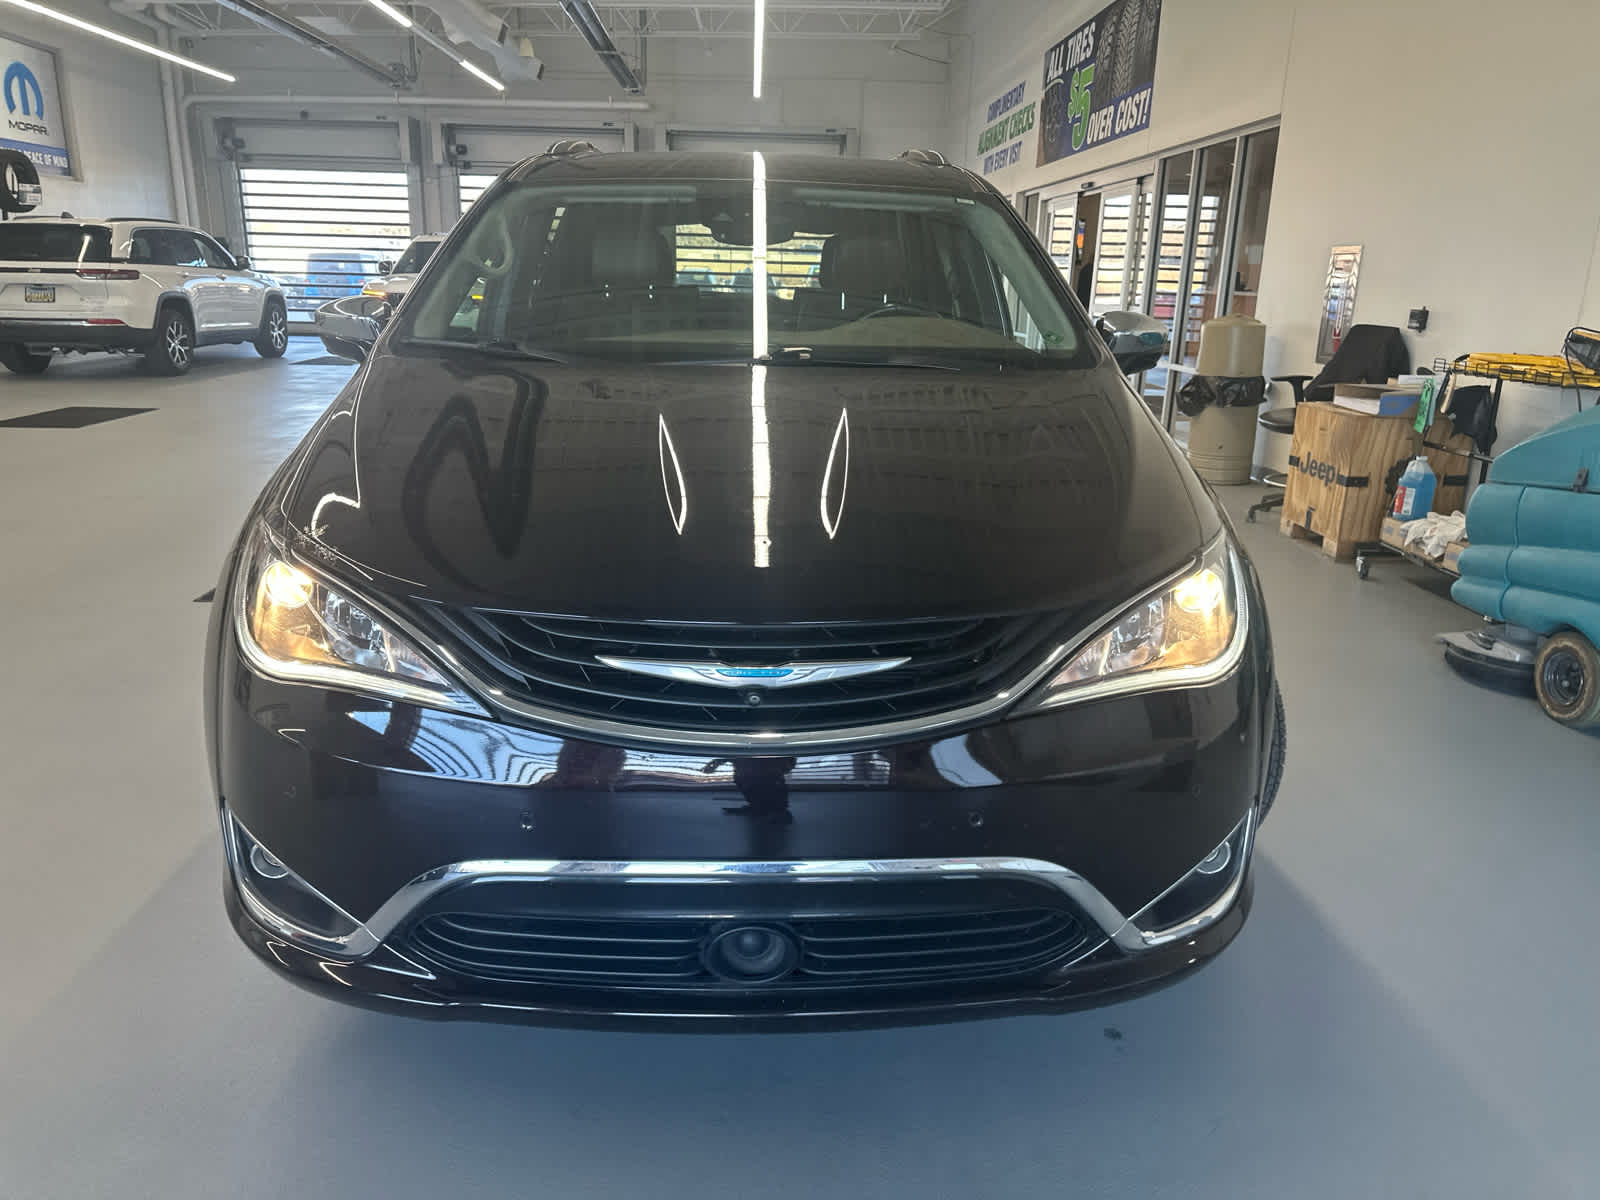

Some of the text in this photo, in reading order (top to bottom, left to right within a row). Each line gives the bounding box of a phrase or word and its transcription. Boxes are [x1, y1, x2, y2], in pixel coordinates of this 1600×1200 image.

[1046, 21, 1096, 83] ALL TIRES
[8, 119, 48, 136] MOPAR
[977, 101, 1036, 156] ALIGNMENT CHECKS
[1067, 63, 1095, 151] $5
[1086, 87, 1151, 145] OVER COST!
[44, 153, 52, 166] OF
[53, 154, 69, 168] MIND
[994, 147, 1009, 171] EVERY
[1300, 451, 1336, 488] Jeep
